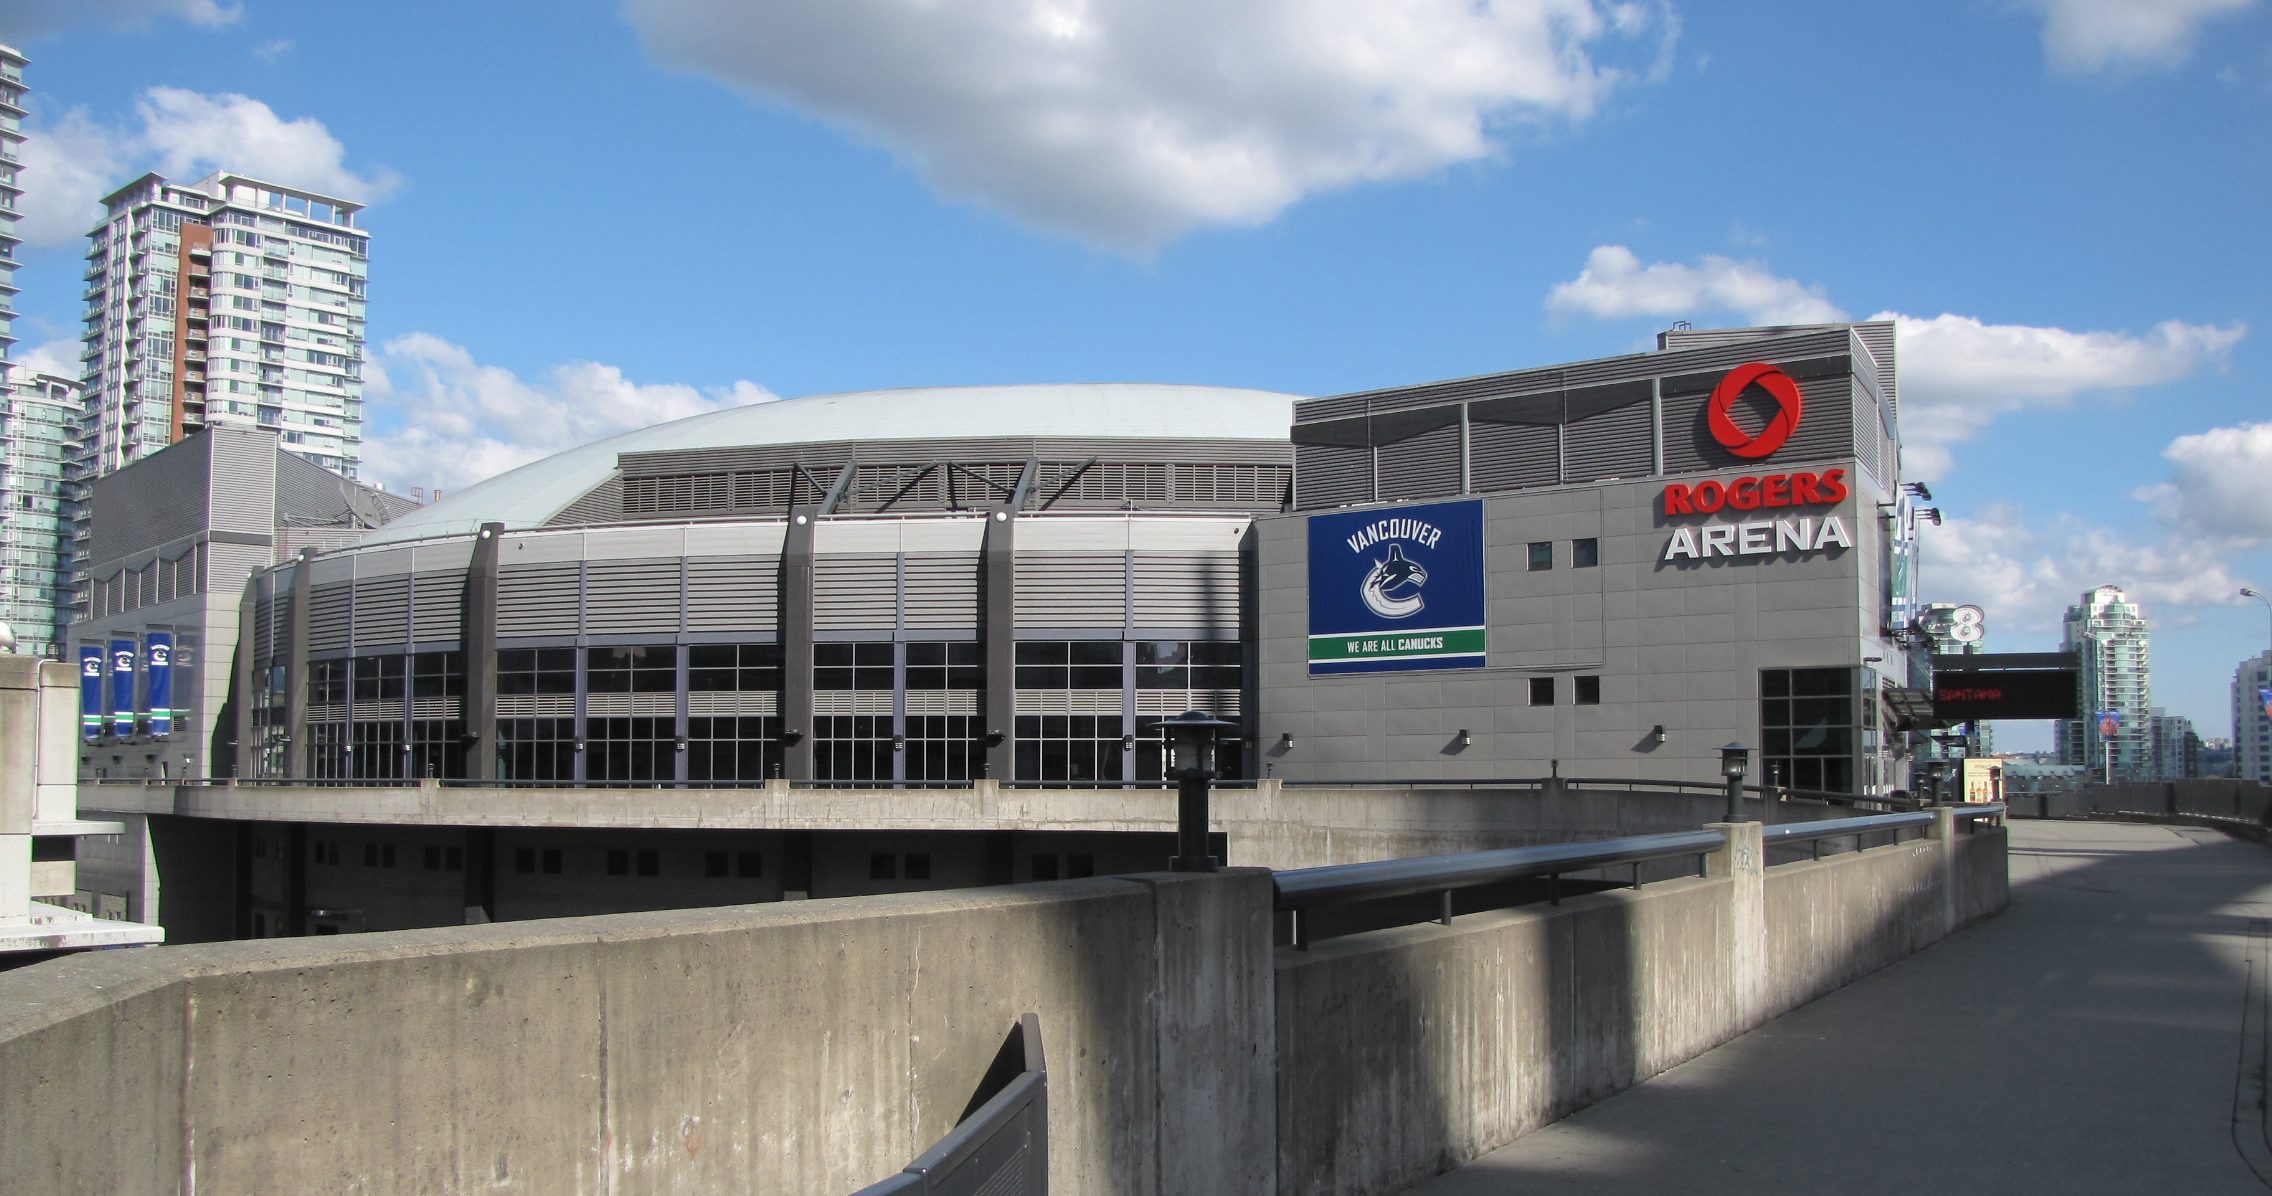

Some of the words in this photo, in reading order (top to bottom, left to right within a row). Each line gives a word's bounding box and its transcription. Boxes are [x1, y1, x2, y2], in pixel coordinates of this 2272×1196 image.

[1664, 468, 1849, 516] ROGERS
[1346, 518, 1442, 554] VANCOUVER
[1664, 516, 1852, 561] ARENA
[1950, 604, 1985, 642] 8
[1347, 641, 1360, 653] WE
[1362, 640, 1378, 652] ARE
[1381, 639, 1396, 652] ALL
[1398, 637, 1443, 651] CANUCKS
